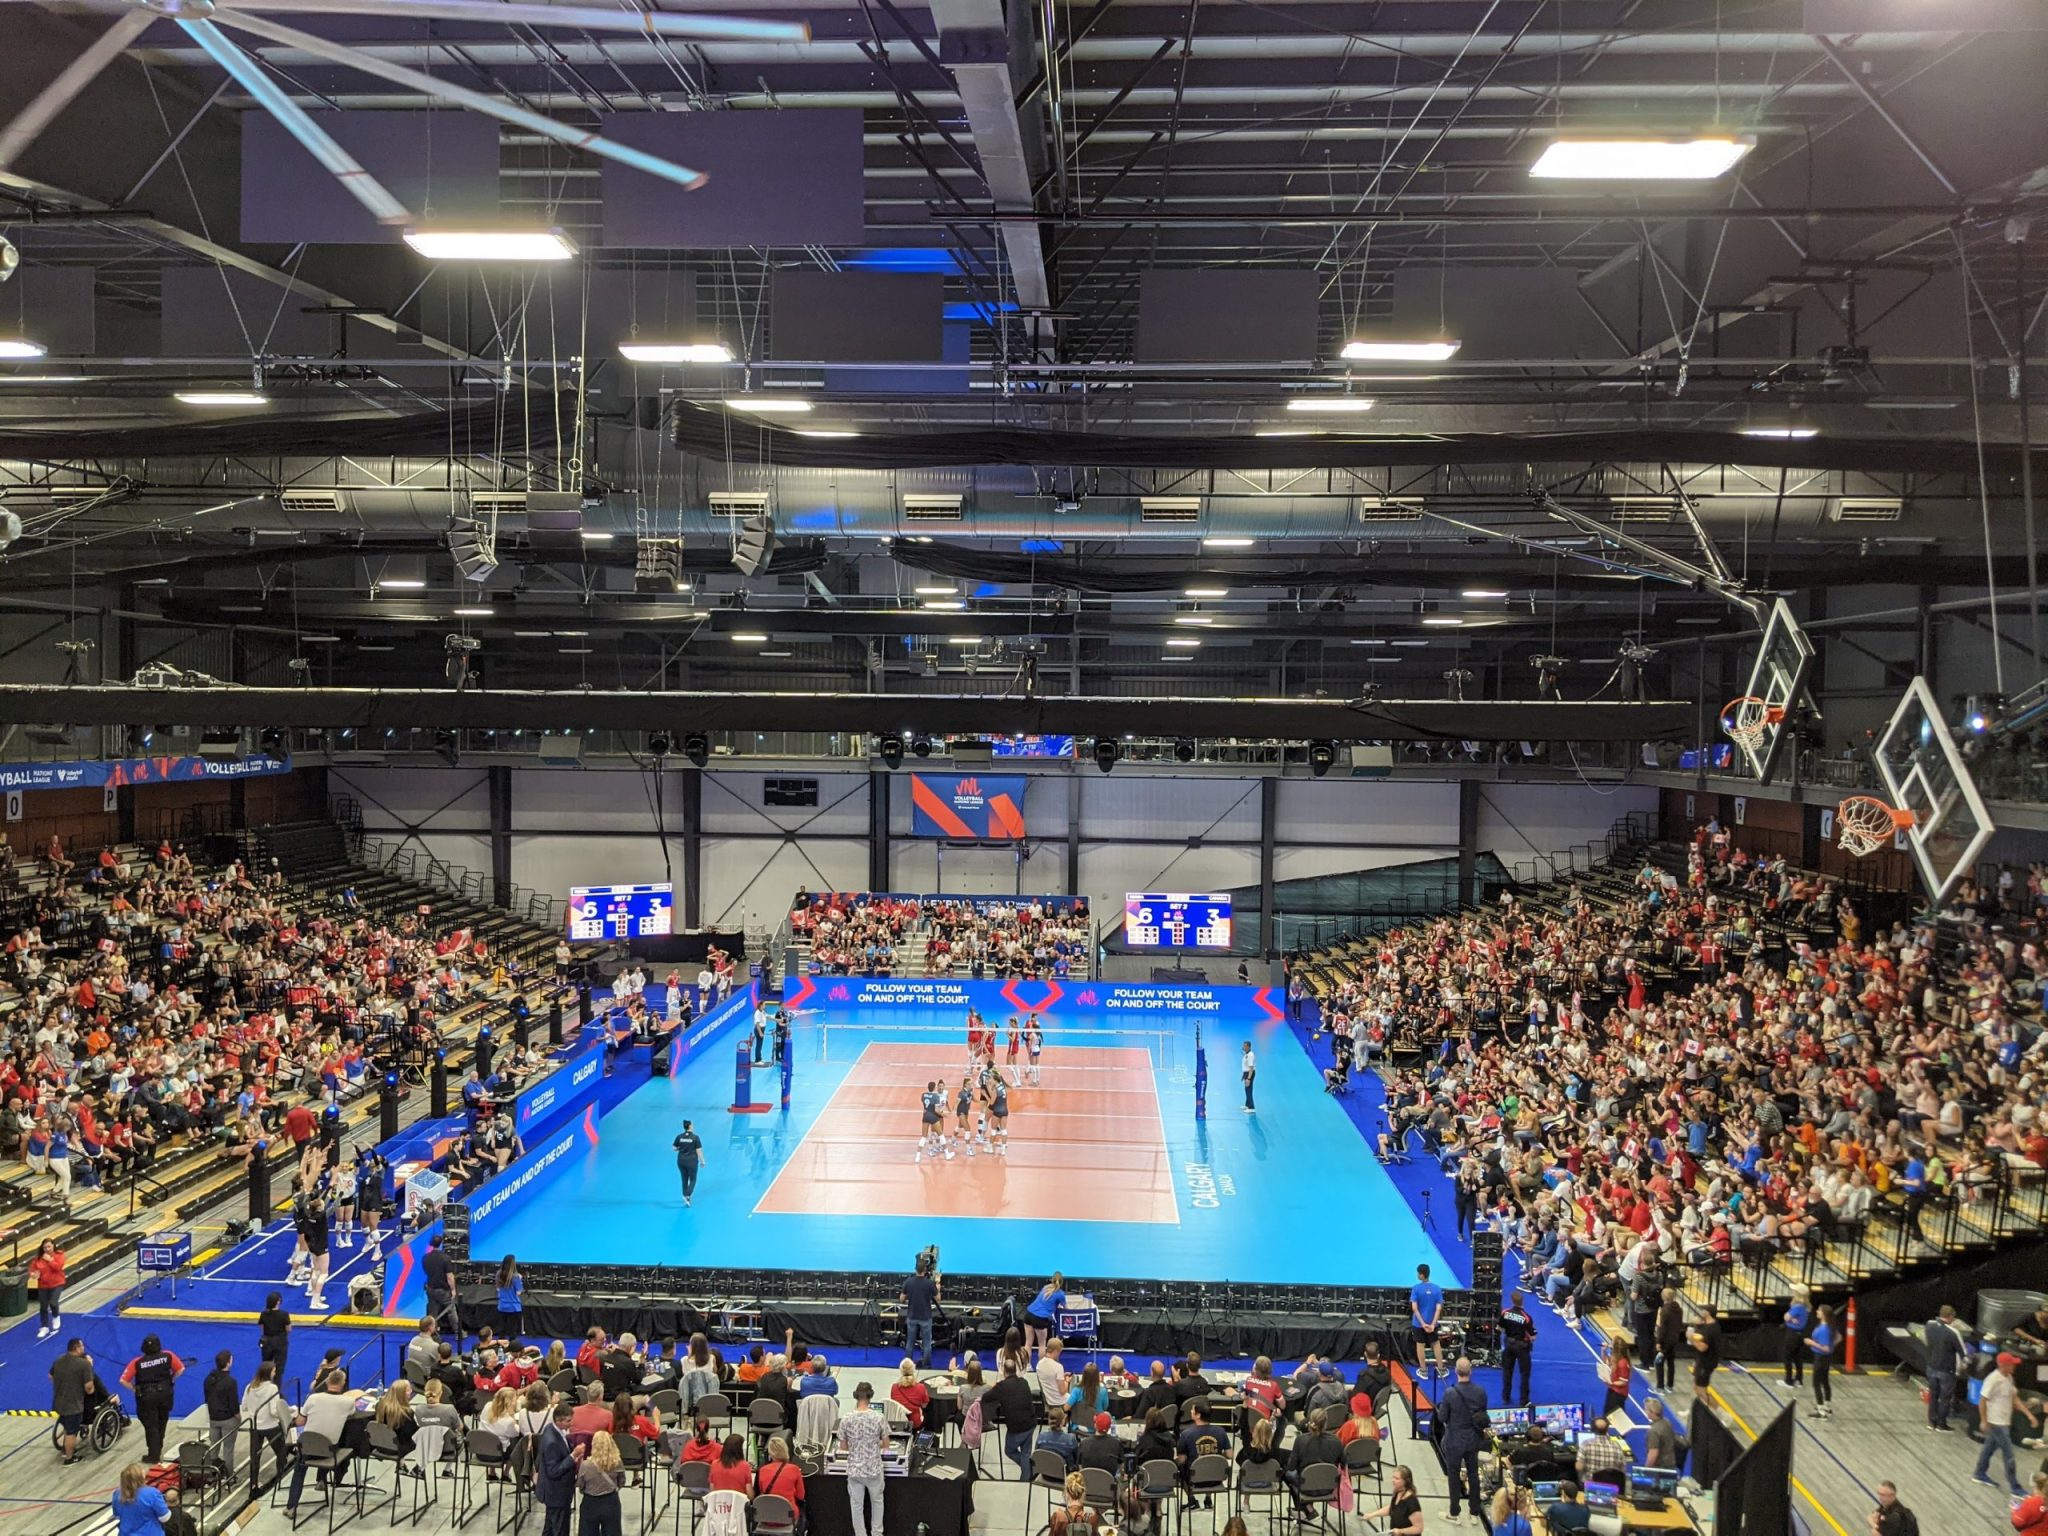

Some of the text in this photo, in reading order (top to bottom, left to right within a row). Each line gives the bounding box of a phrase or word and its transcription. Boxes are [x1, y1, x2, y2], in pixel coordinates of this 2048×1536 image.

[107, 790, 114, 808] P
[583, 901, 598, 918] 6
[649, 898, 662, 914] 3
[1138, 907, 1153, 924] 6
[1207, 908, 1220, 925] 3
[866, 984, 961, 994] FOLLOW YOUR TEAM
[1114, 989, 1212, 999] FOLLOW YOUR TEAM
[858, 994, 970, 1004] ON AND OFF THE COURT
[1106, 999, 1220, 1010] ON AND OFF THE COURT
[573, 1058, 598, 1085] CALGARY
[473, 1134, 574, 1224] YOUR TEAM ON AND OFF THE COURT
[1184, 1162, 1220, 1208] CALGARY
[140, 1357, 168, 1368] SECURITY
